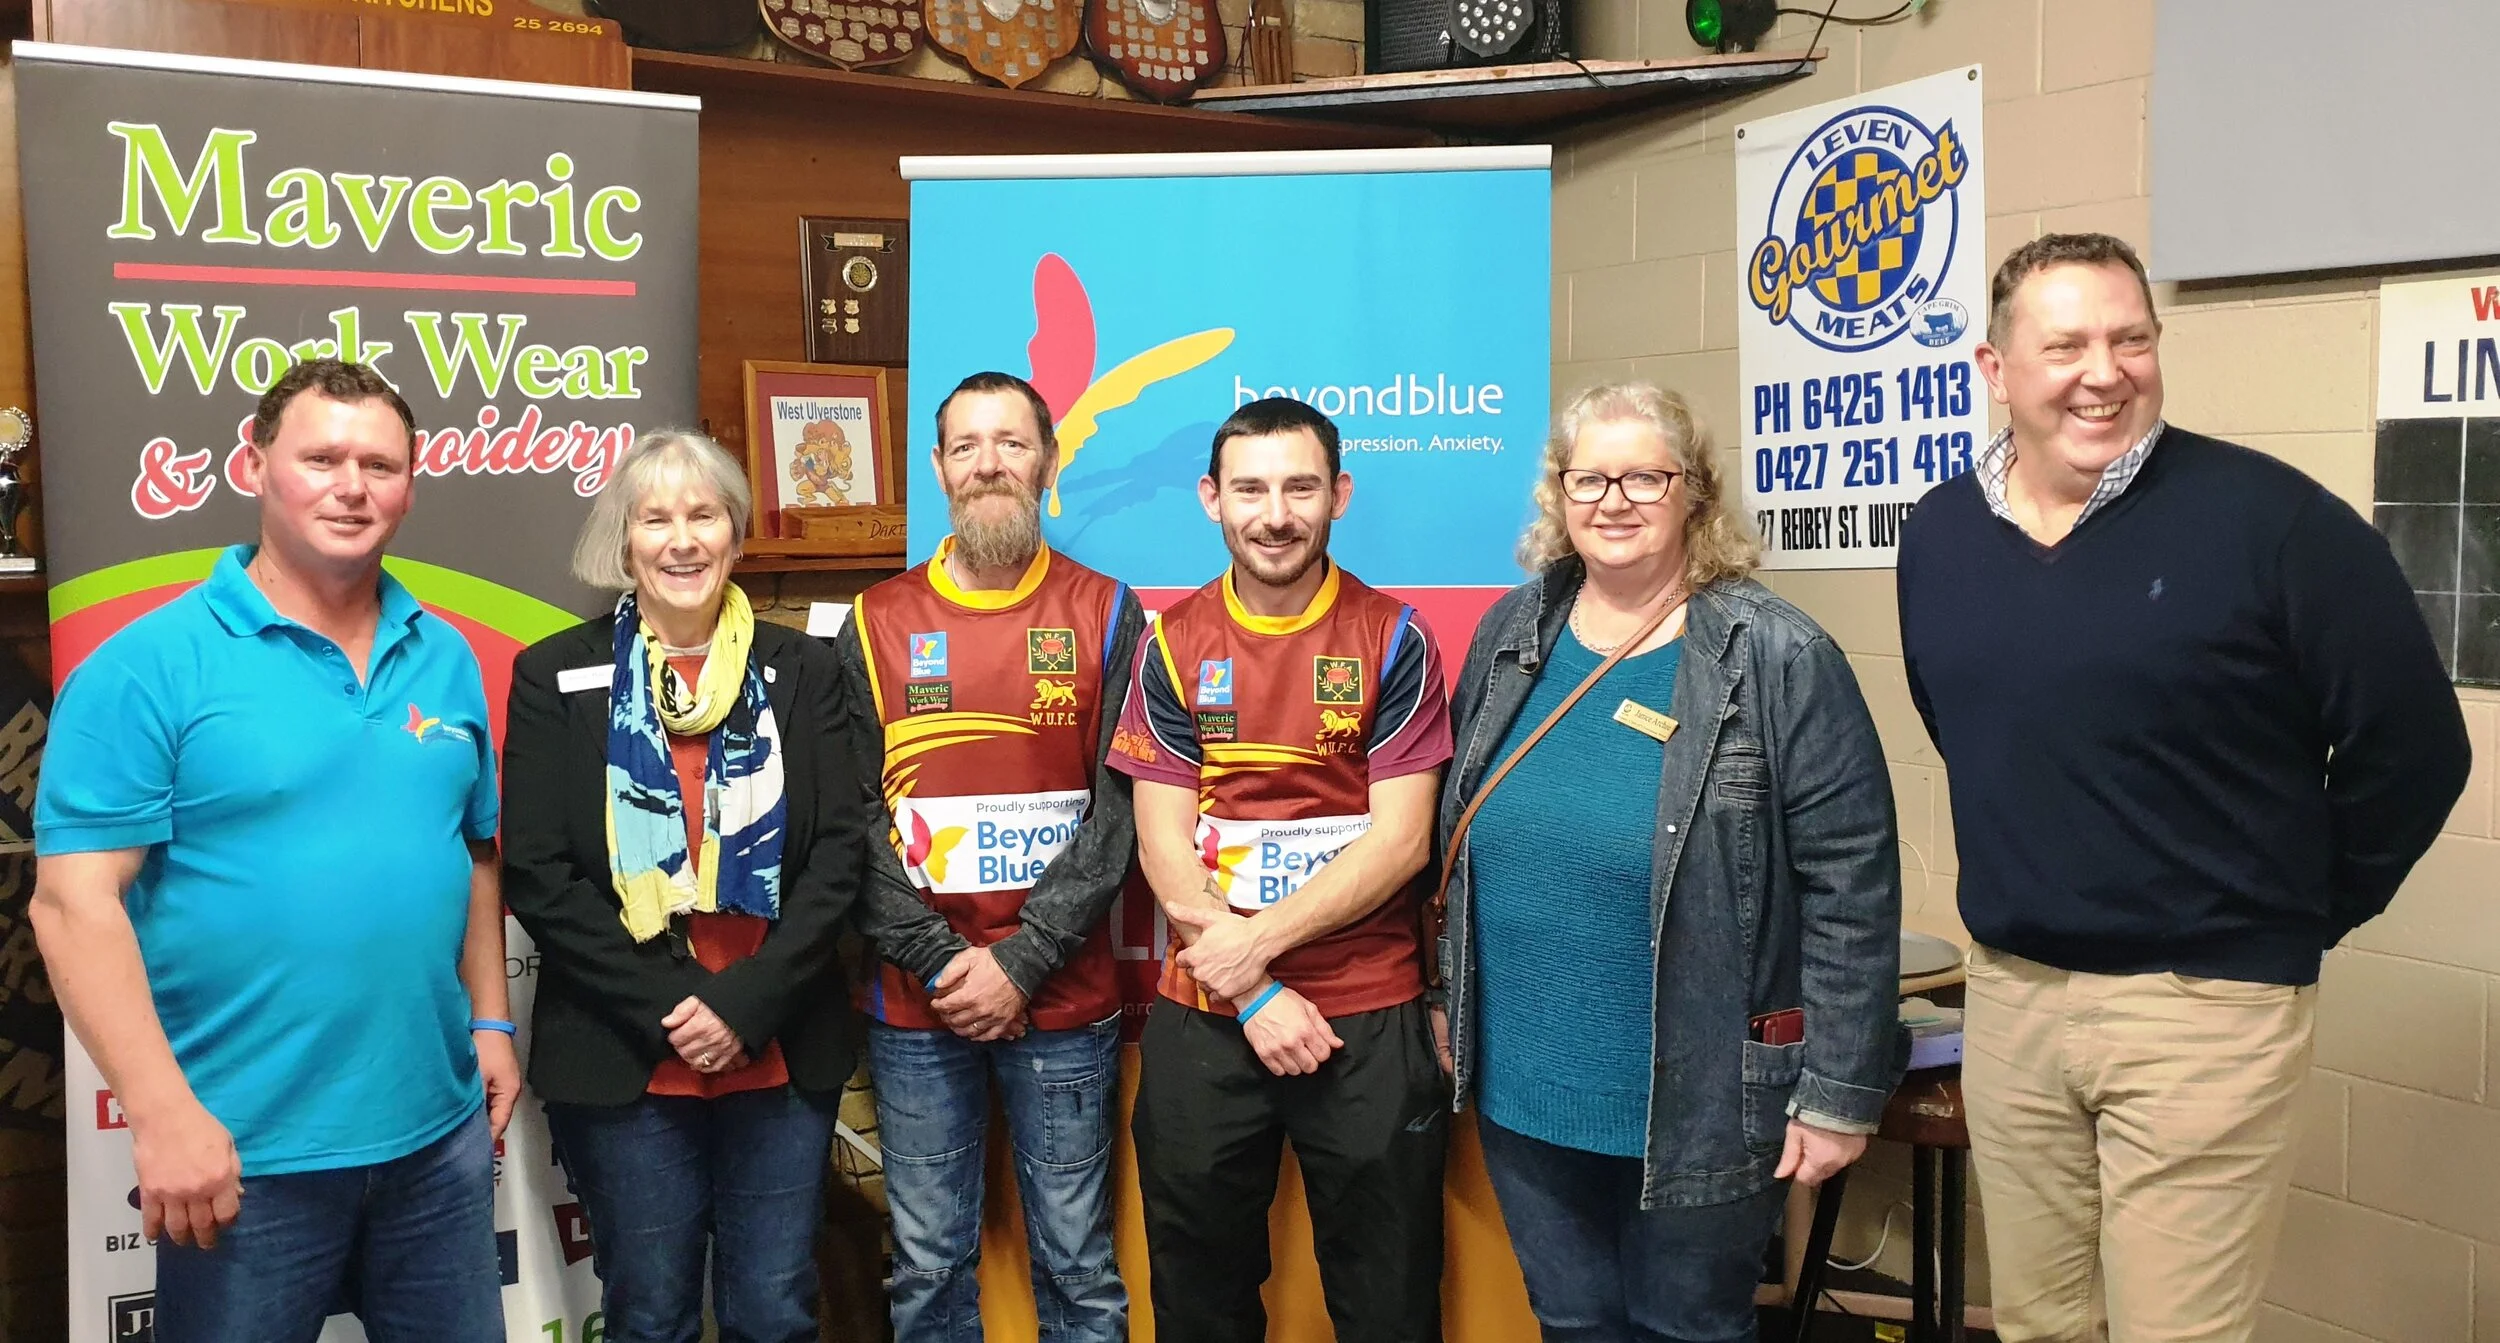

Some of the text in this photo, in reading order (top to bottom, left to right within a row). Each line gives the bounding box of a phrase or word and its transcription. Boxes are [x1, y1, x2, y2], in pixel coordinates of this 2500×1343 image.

[513, 17, 603, 35] 25 2694
[1805, 119, 1912, 171] LEVEN
[107, 121, 642, 261] Maveric
[1748, 117, 1969, 326] Gourmet
[1815, 273, 1930, 339] MEATS
[405, 310, 648, 398] Wear
[777, 401, 862, 420] West Ulverstone
[1754, 361, 1972, 435] PH 6425 1413
[1339, 434, 1504, 456] pression. Anxiety.
[132, 405, 635, 519] & oidery
[1756, 431, 1973, 493] 0427 251 413
[1781, 506, 1832, 551] REIBEY
[1838, 505, 1862, 549] ST.
[1868, 502, 1916, 548] ULVE
[912, 658, 944, 668] Beyond
[912, 667, 931, 676] Blue
[908, 685, 949, 694] Maveric
[1200, 685, 1231, 696] Beyond
[1198, 713, 1235, 723] Maveric
[976, 797, 1086, 814] Proudly supporting
[977, 808, 1083, 857] Beyond
[1261, 820, 1373, 838] Proudly supportin
[979, 855, 1045, 885] Blue
[1261, 842, 1351, 876] Beyo
[106, 1233, 141, 1253] BIZ
